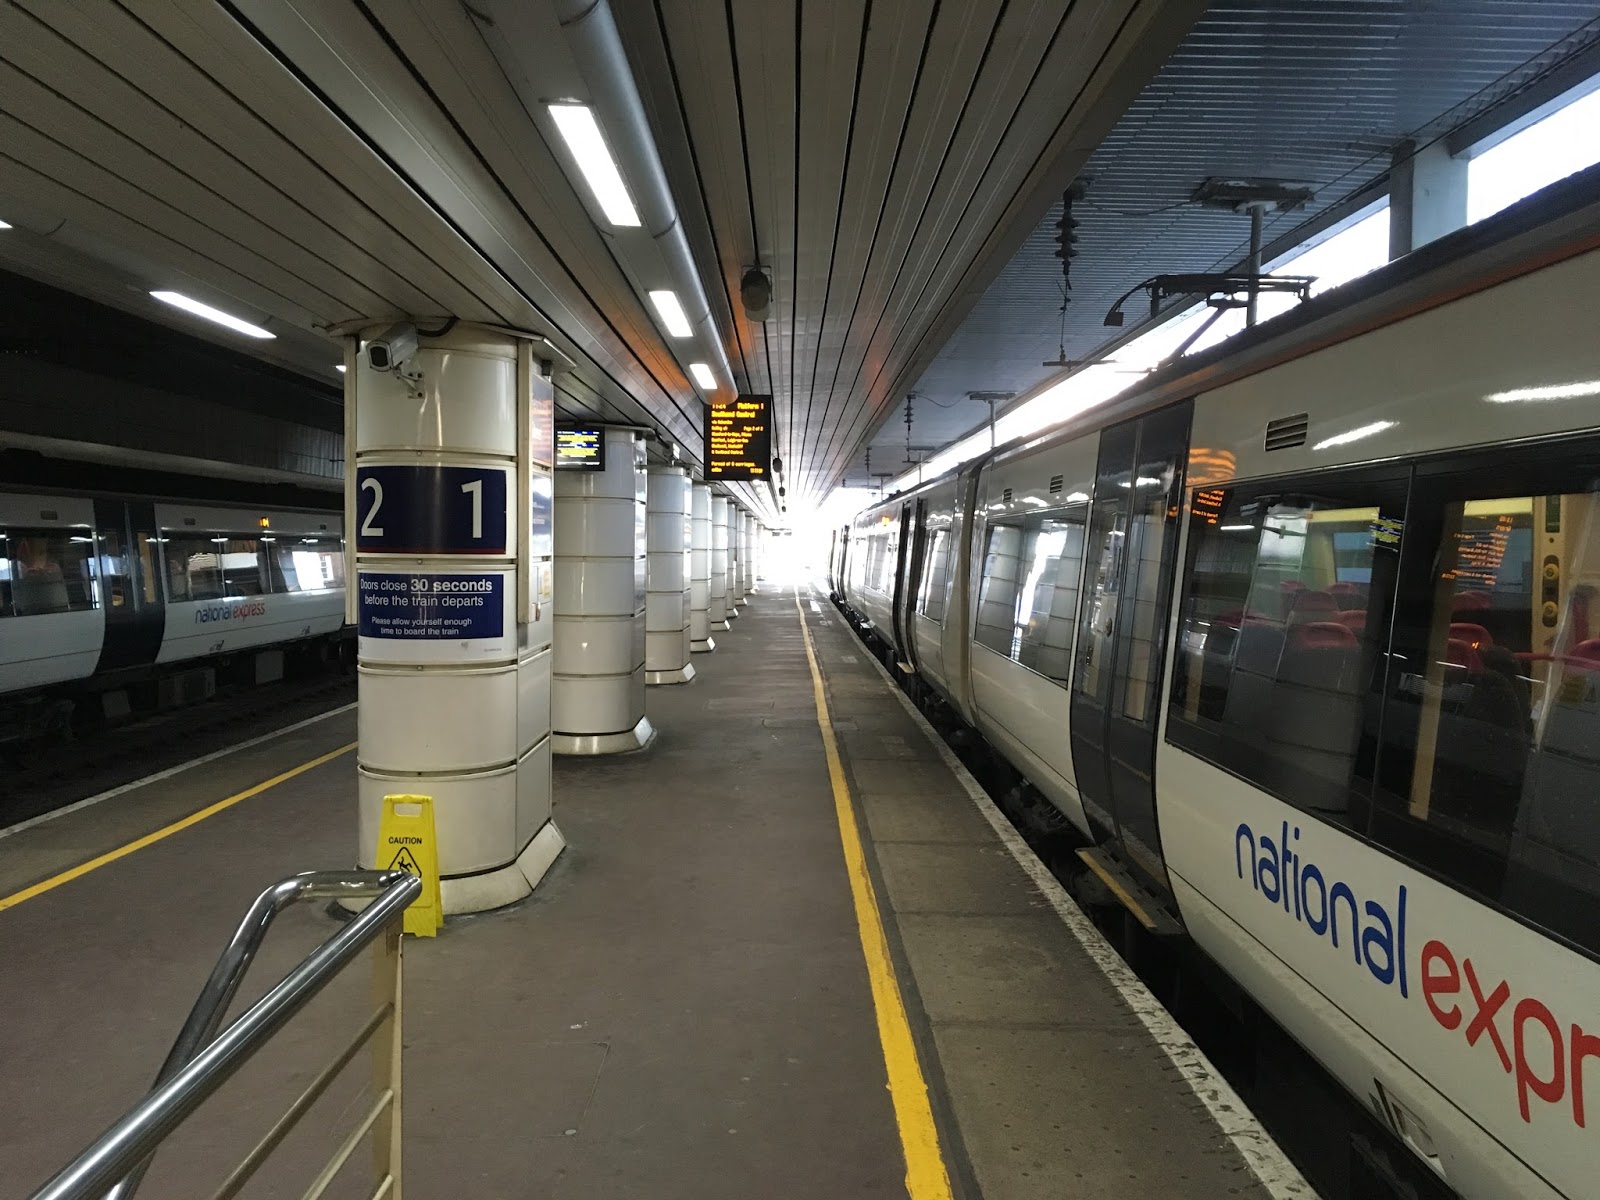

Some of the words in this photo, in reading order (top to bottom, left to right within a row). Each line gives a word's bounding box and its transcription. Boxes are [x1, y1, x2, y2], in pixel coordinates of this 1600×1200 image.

[361, 477, 384, 537] 2
[461, 479, 482, 538] 1
[360, 578, 379, 591] Doors
[380, 579, 407, 591] close
[410, 578, 428, 592] 30
[433, 578, 493, 592] seconds
[364, 594, 389, 606] before
[392, 595, 409, 606] the
[412, 595, 438, 607] train
[441, 595, 484, 609] departs
[195, 603, 232, 624] national
[232, 602, 265, 623] express
[371, 616, 391, 625] Please
[392, 616, 410, 626] allow
[411, 616, 442, 627] yourself
[443, 617, 473, 627] enough
[380, 626, 394, 635] time
[395, 627, 403, 635] to
[403, 627, 426, 636] board
[427, 627, 441, 636] the
[441, 628, 459, 636] train
[388, 836, 422, 844] CAUTION
[1235, 820, 1408, 999] national
[1421, 940, 1600, 1128] expr
